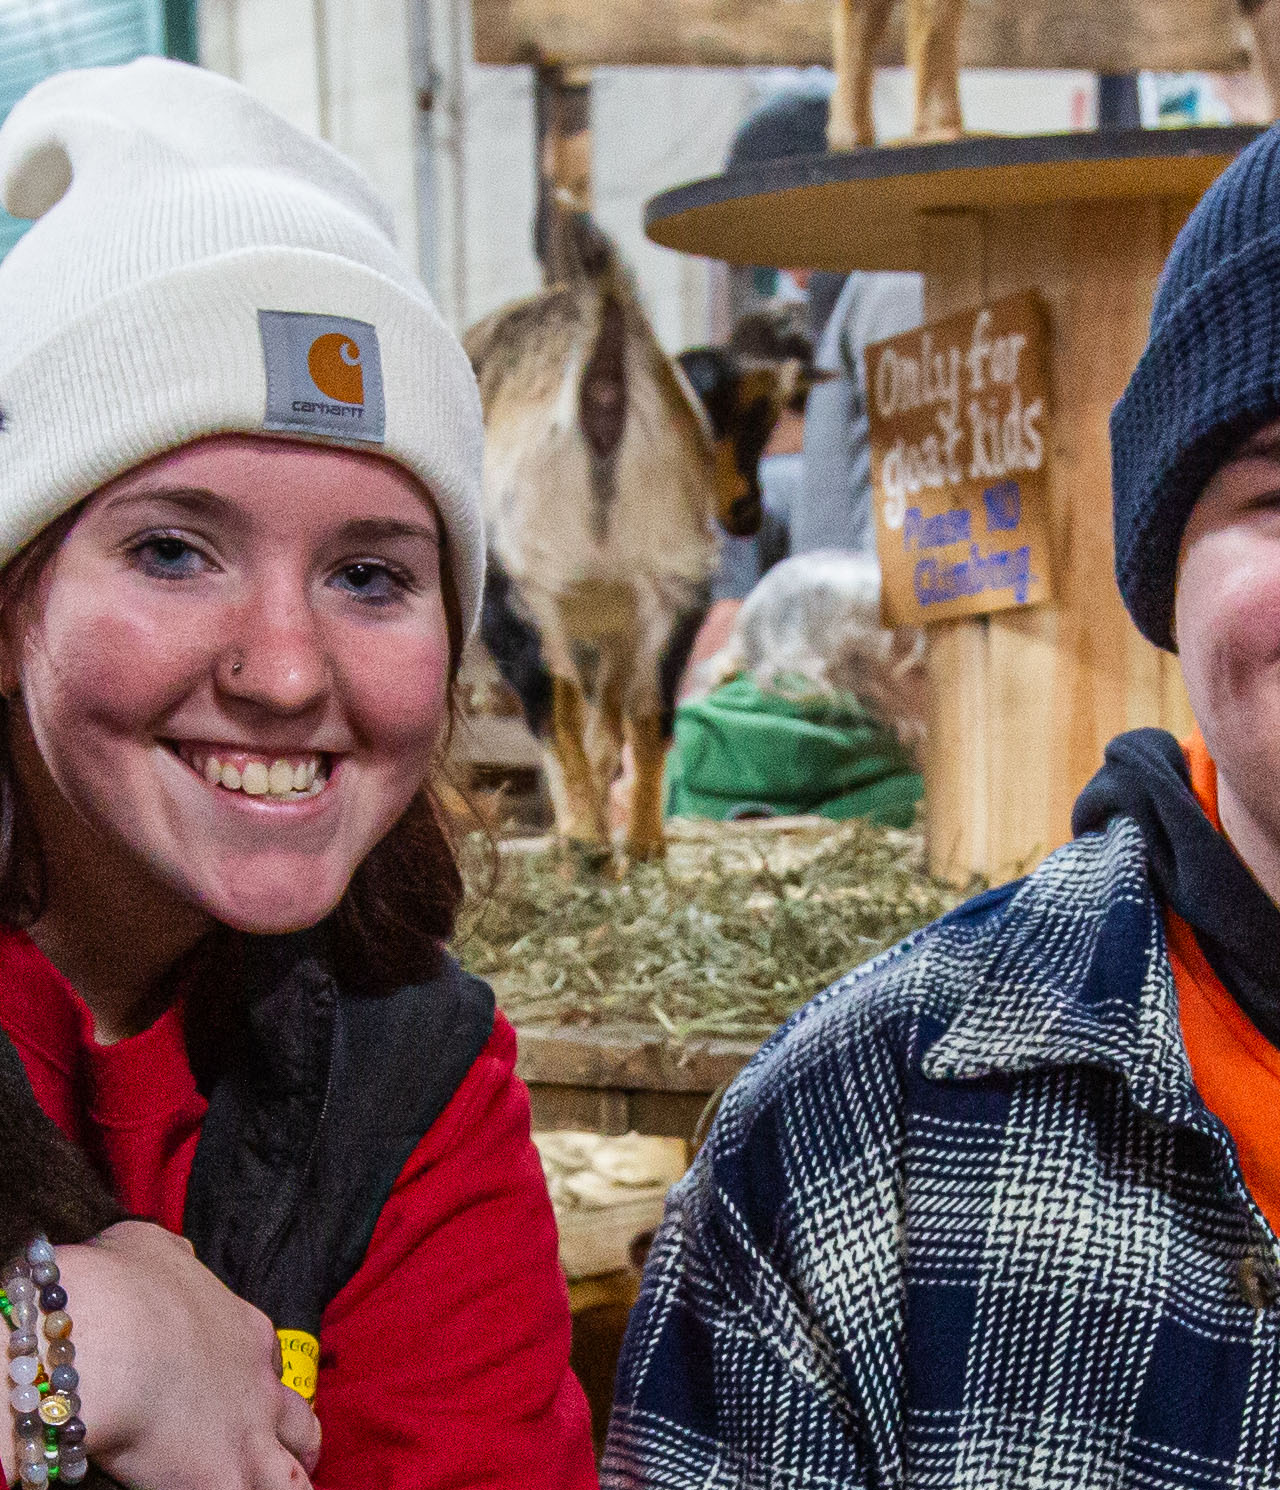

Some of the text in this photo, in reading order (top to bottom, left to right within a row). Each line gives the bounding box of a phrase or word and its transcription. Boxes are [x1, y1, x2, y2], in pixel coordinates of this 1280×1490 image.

[292, 400, 365, 418] carhartt
[875, 310, 1028, 424] Only for
[881, 385, 1045, 529] goat kids
